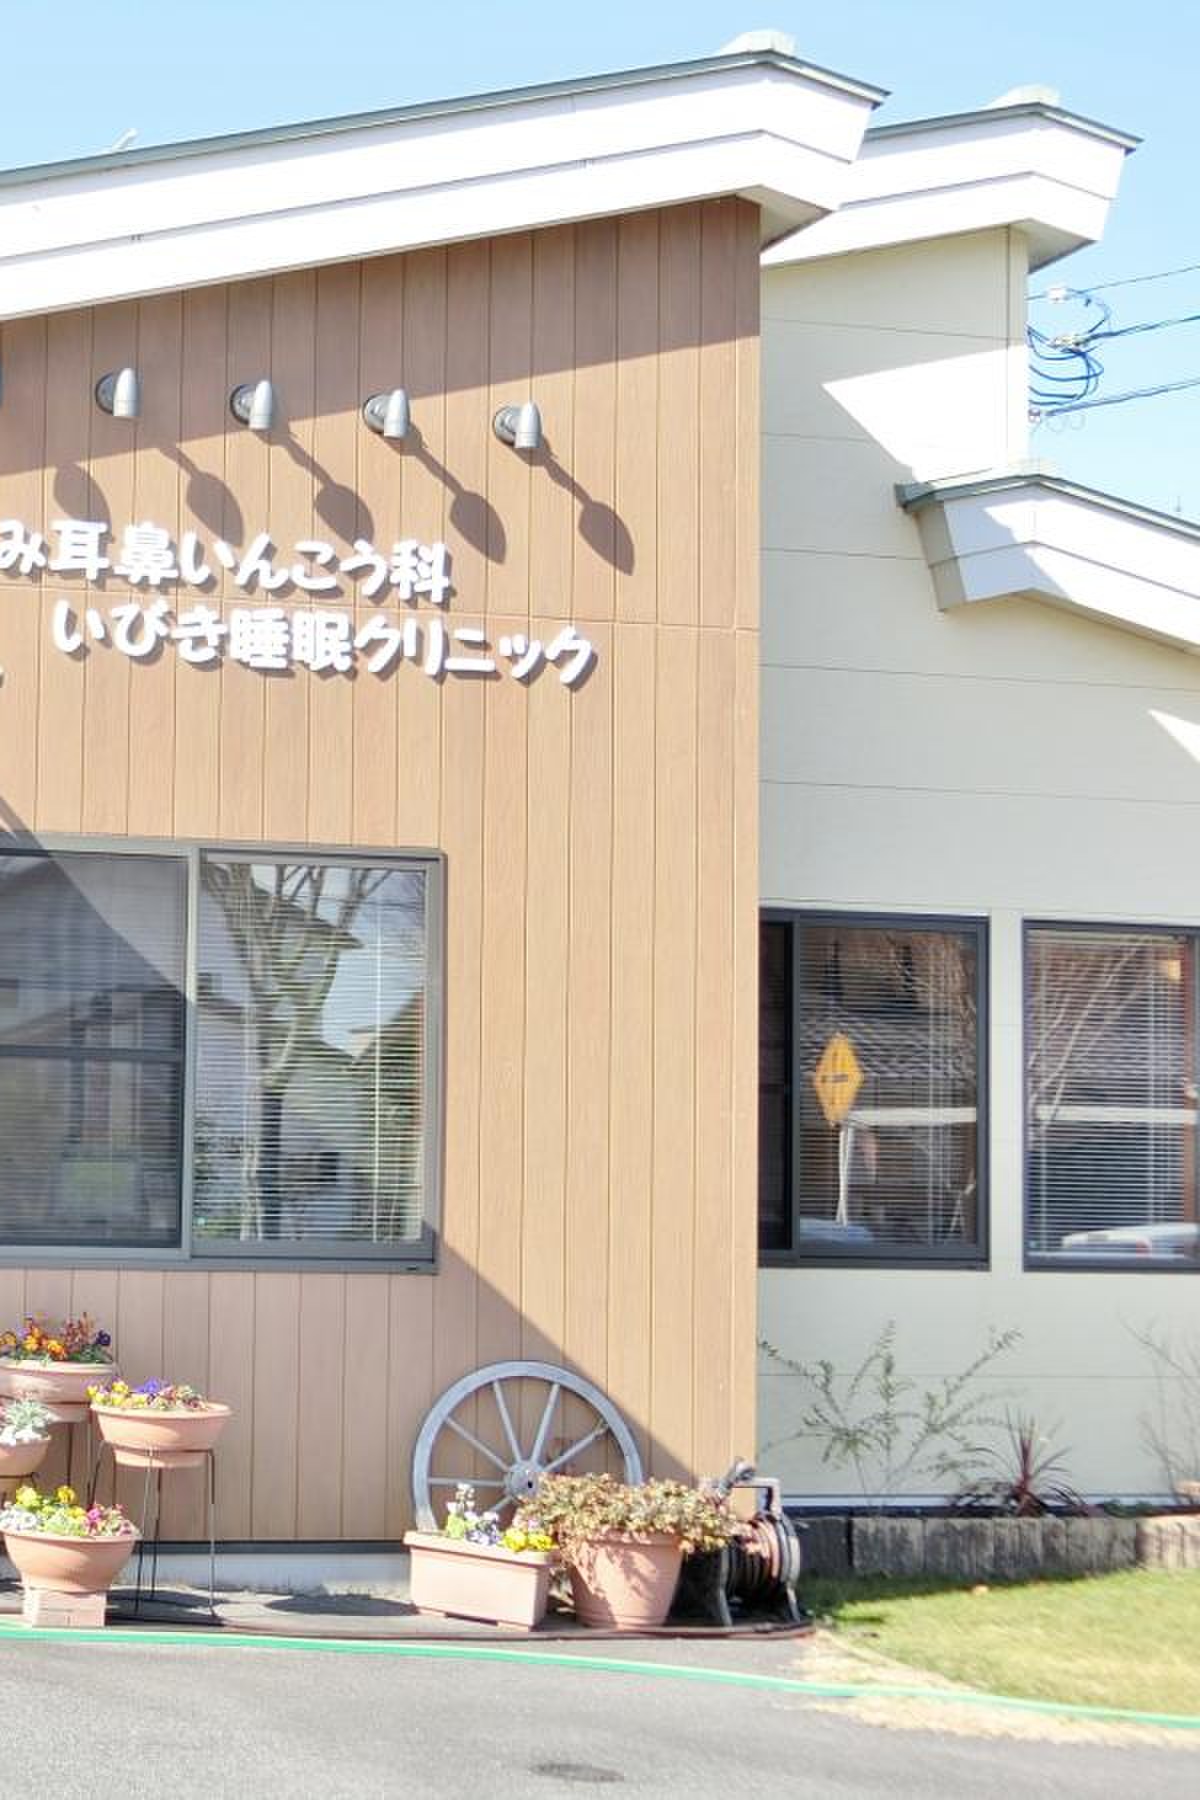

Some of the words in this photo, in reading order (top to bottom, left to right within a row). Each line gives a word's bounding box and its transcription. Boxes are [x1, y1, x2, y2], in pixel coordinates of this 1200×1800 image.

[52, 599, 594, 687] いびき睡眠クリニック
